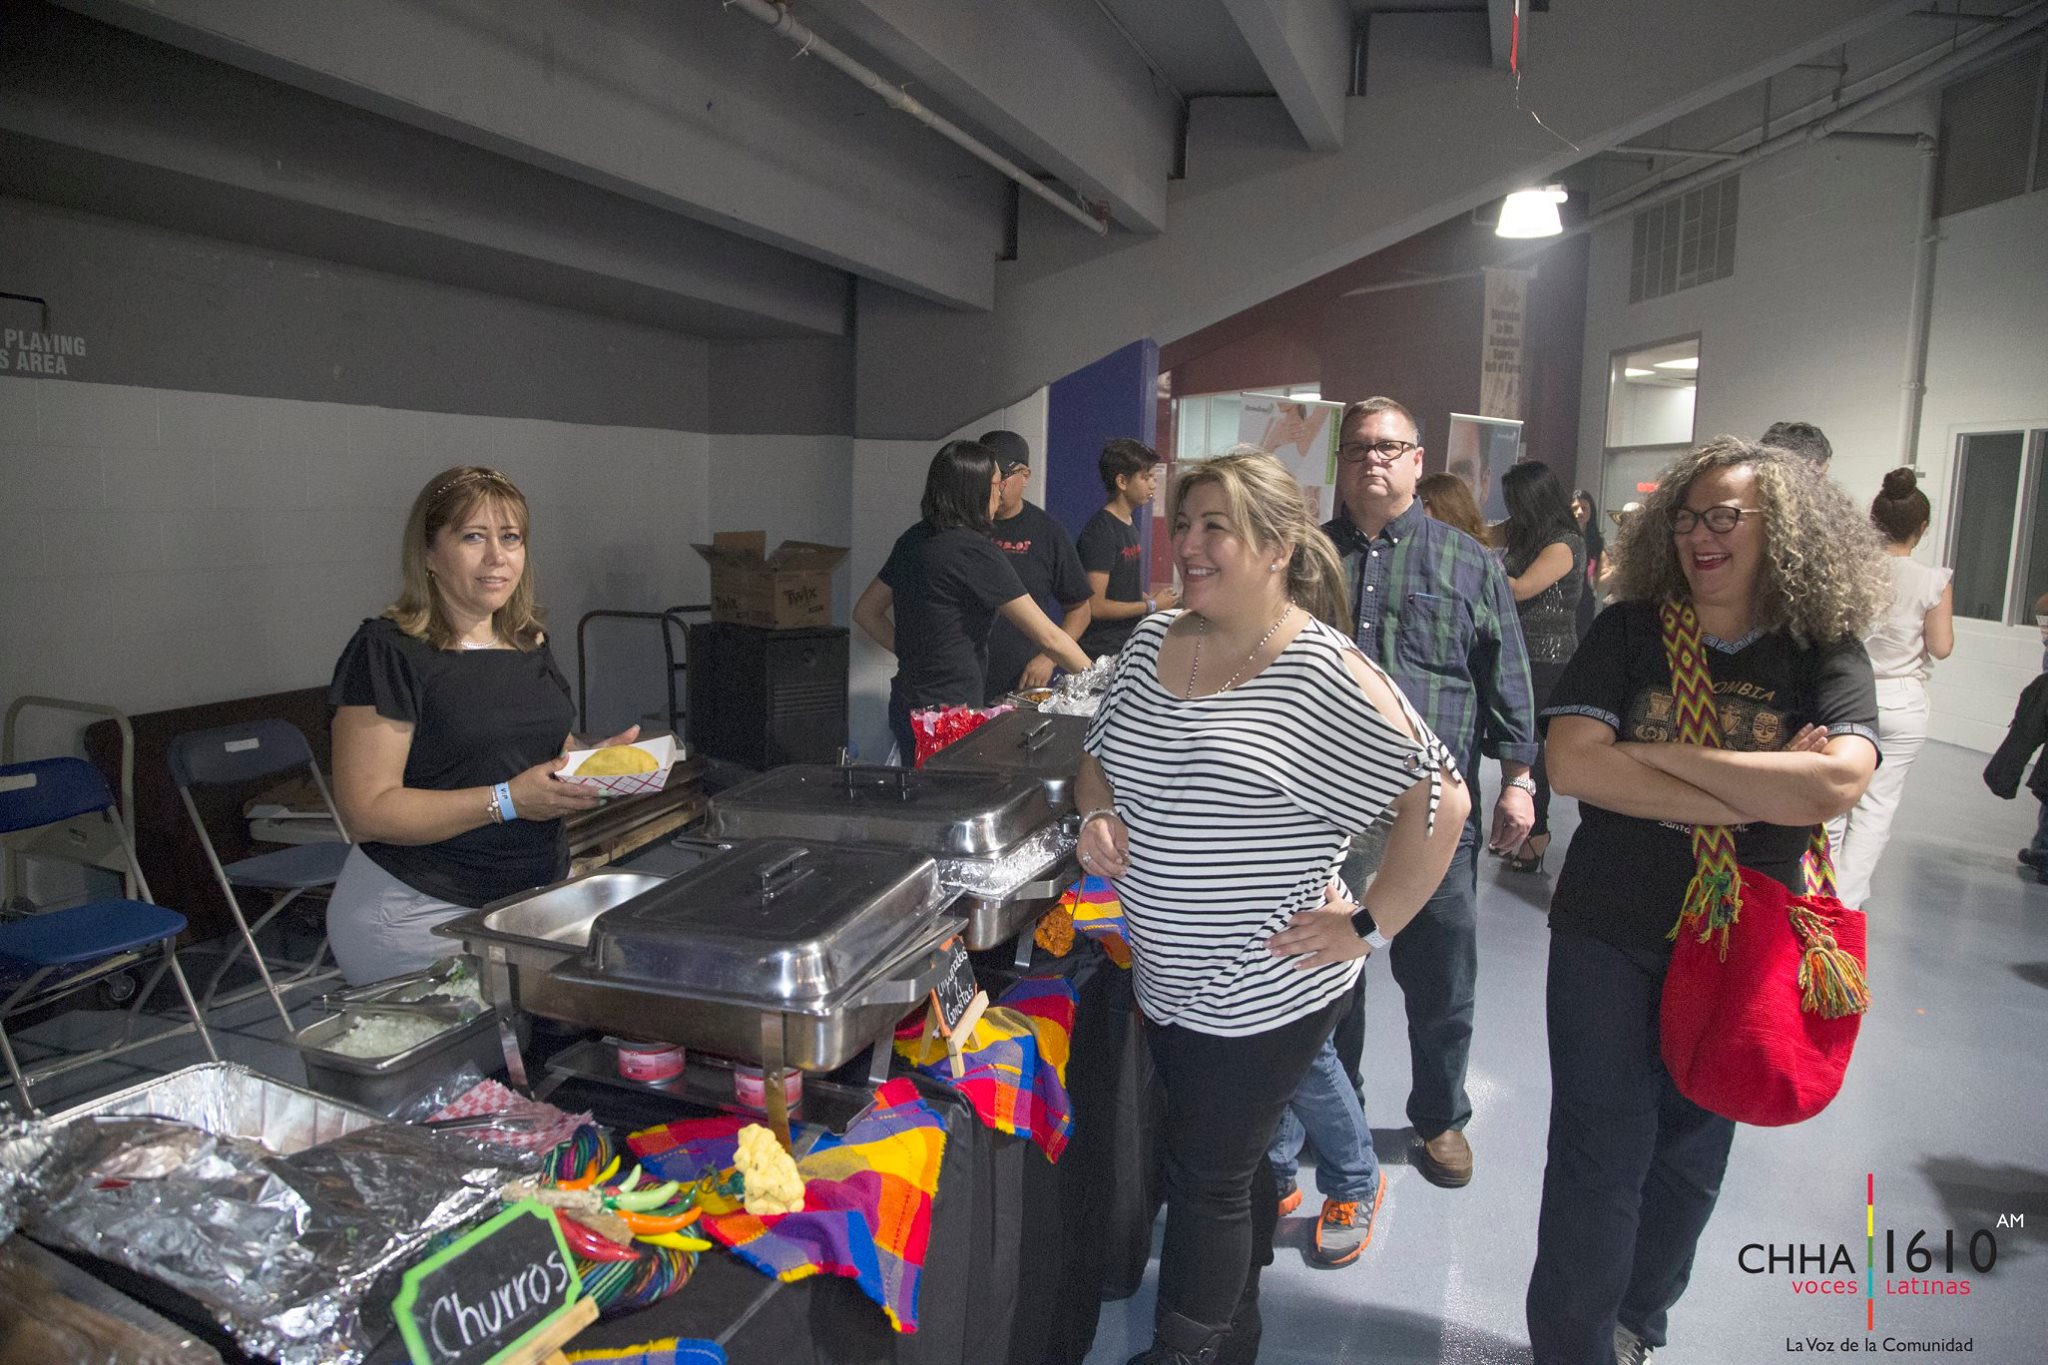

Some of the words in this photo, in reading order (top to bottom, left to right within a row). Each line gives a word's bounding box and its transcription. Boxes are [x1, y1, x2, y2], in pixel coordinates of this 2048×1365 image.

[4, 328, 86, 356] PLAYING
[16, 351, 68, 375] AREA
[1711, 681, 1776, 702] OMBIA
[430, 1250, 568, 1358] Churros
